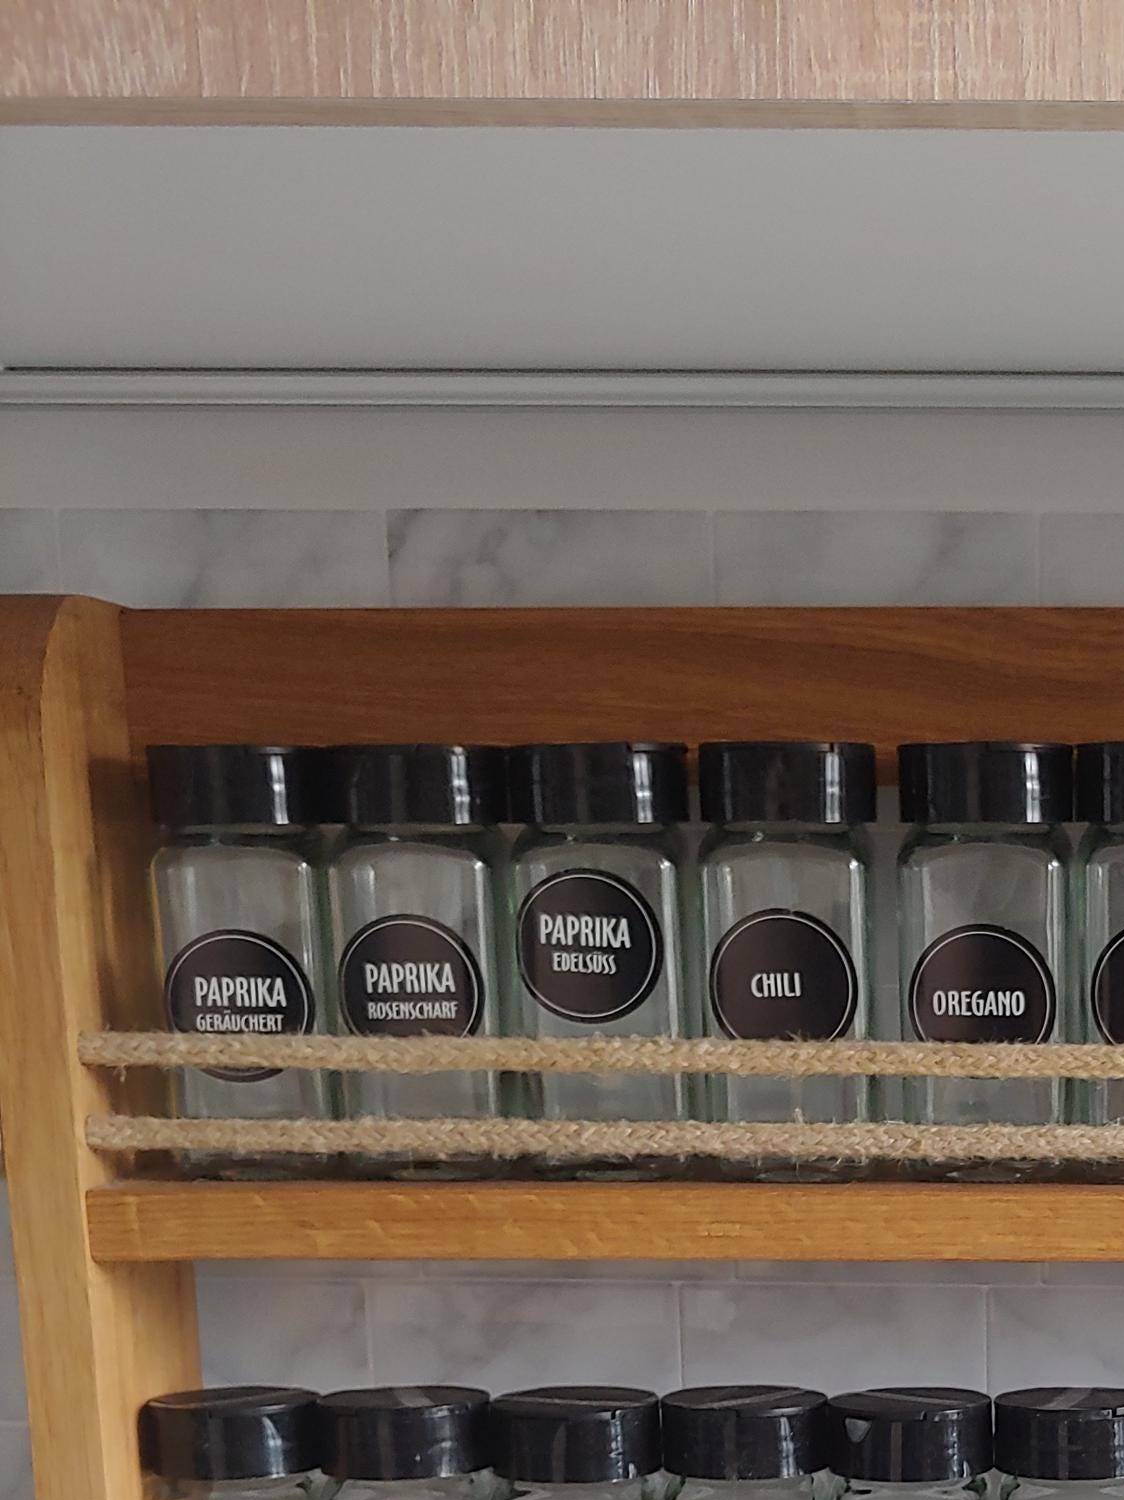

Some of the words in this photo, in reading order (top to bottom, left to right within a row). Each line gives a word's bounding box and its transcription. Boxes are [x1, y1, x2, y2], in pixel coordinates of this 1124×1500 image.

[539, 914, 631, 949] PAPRIKA
[552, 951, 617, 975] EDELSÜSS
[365, 963, 455, 994] PAPRIKA
[751, 973, 801, 998] CHILI
[195, 976, 287, 1008] PAPRIKA
[933, 990, 1026, 1017] OREGANO
[196, 1010, 284, 1033] GERÄUCHERT
[368, 1000, 458, 1021] ROSENSCHARF
